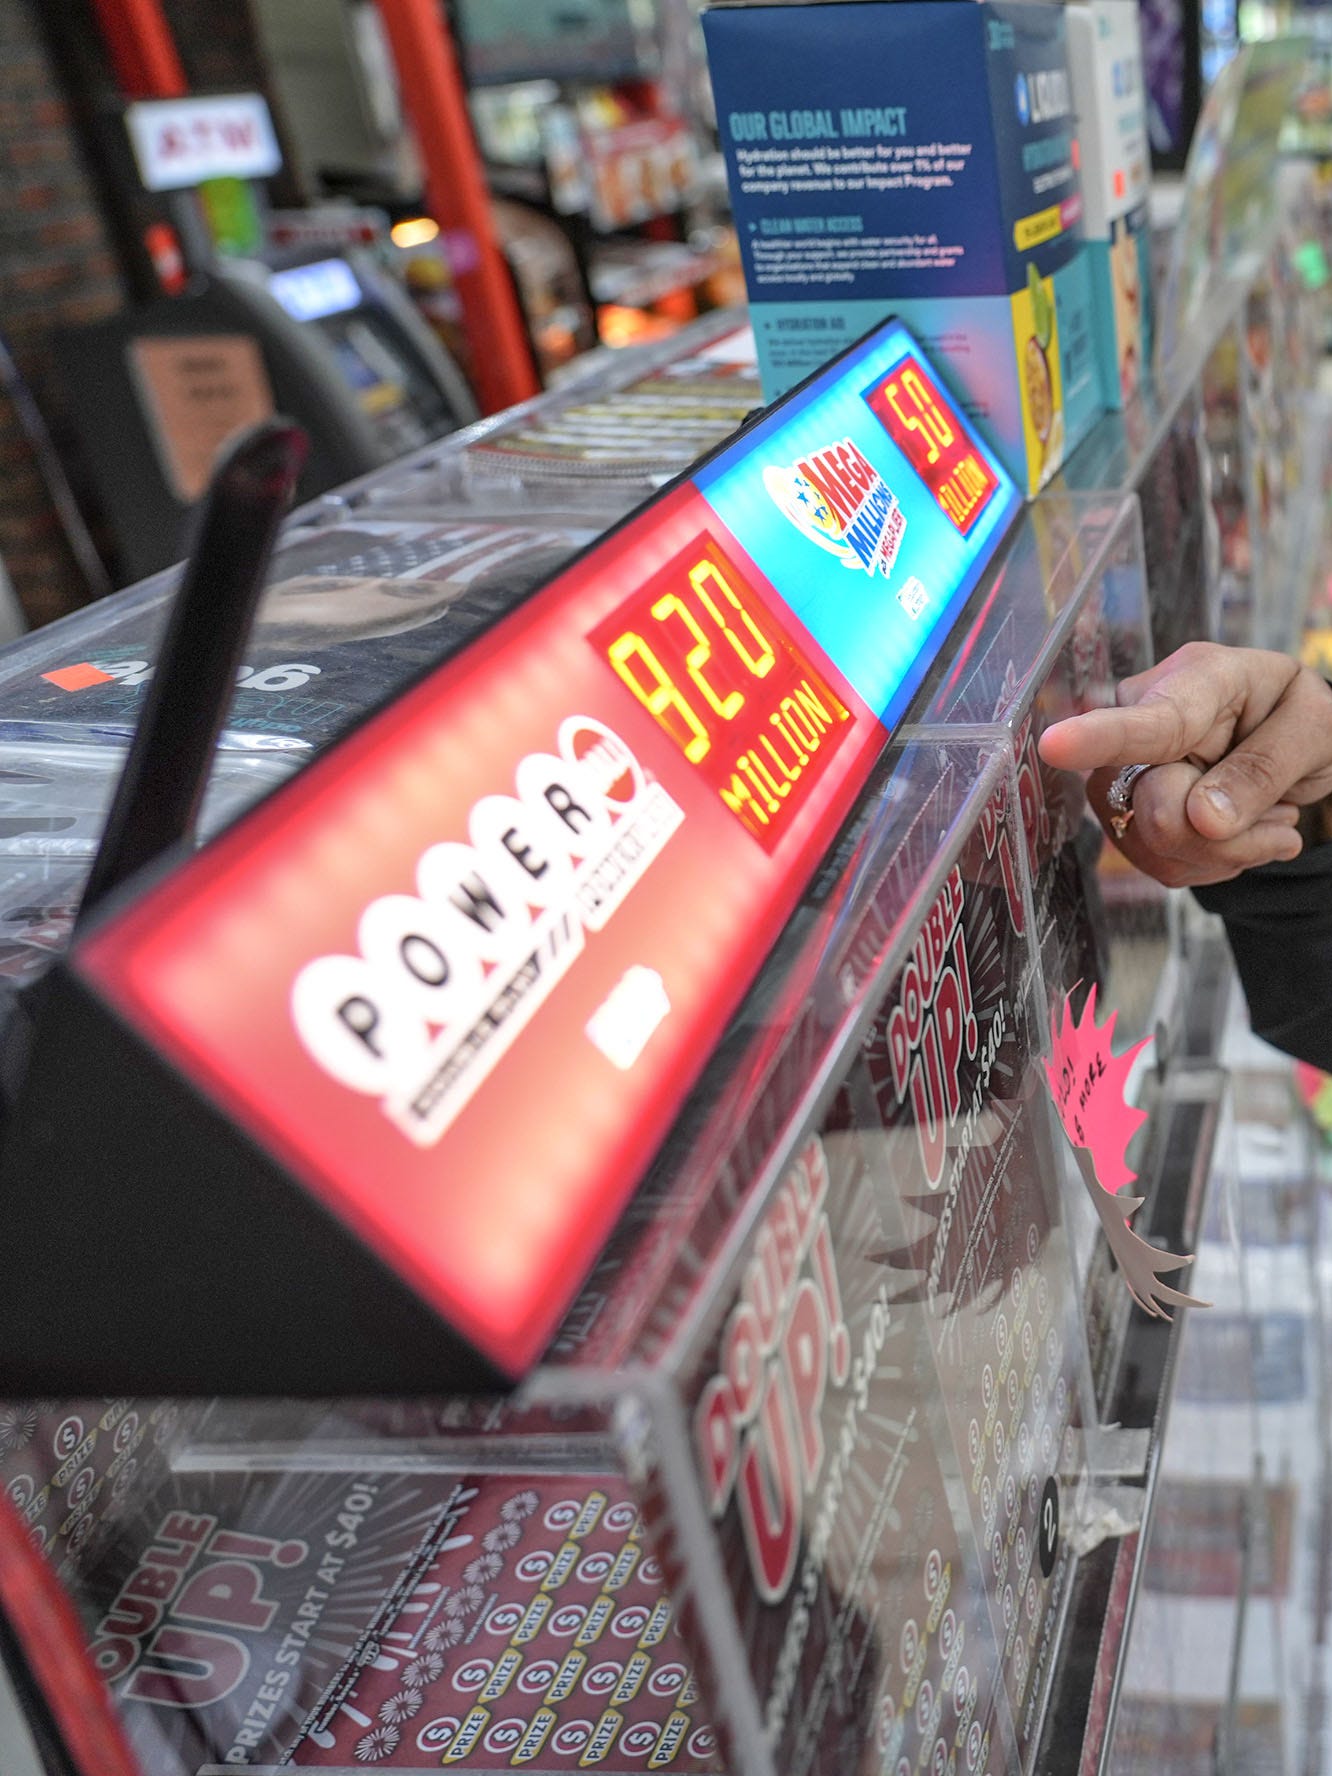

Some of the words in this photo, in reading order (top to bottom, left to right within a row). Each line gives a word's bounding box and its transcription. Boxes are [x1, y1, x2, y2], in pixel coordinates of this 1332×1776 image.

[729, 112, 768, 141] OUR
[768, 110, 839, 140] GLOBAL
[840, 107, 906, 138] IMPACT
[884, 367, 954, 465] 50
[798, 441, 878, 530] MEGA
[846, 484, 896, 568] MILLIONS
[608, 559, 776, 765] 920
[720, 680, 833, 825] MILLION
[336, 782, 592, 1060] POWER
[887, 864, 964, 1104] DOUBLE
[909, 922, 978, 1190] UP!
[970, 1073, 984, 1126] AT
[980, 998, 1006, 1088] $40!
[1080, 1051, 1107, 1112] MORE
[739, 1211, 849, 1604] UP!
[325, 1482, 379, 1551] $40!
[577, 1498, 602, 1534] PRIZE
[88, 1510, 217, 1682] OUBLE
[317, 1551, 346, 1585] AT
[548, 1549, 575, 1586] PRIZE
[610, 1550, 636, 1588] PRIZE
[121, 1529, 309, 1708] UP!
[275, 1585, 330, 1668] START
[518, 1599, 548, 1640] PRIZE
[582, 1601, 609, 1641] PRIZE
[486, 1656, 518, 1697] PRIZE
[552, 1657, 582, 1698] PRIZE
[617, 1659, 646, 1700] PRIZE
[225, 1666, 290, 1766] PRIZES
[451, 1713, 485, 1757] PRIZE
[519, 1714, 552, 1759] PRIZE
[587, 1716, 620, 1761] PRIZE
[655, 1718, 687, 1763] PRIZE
